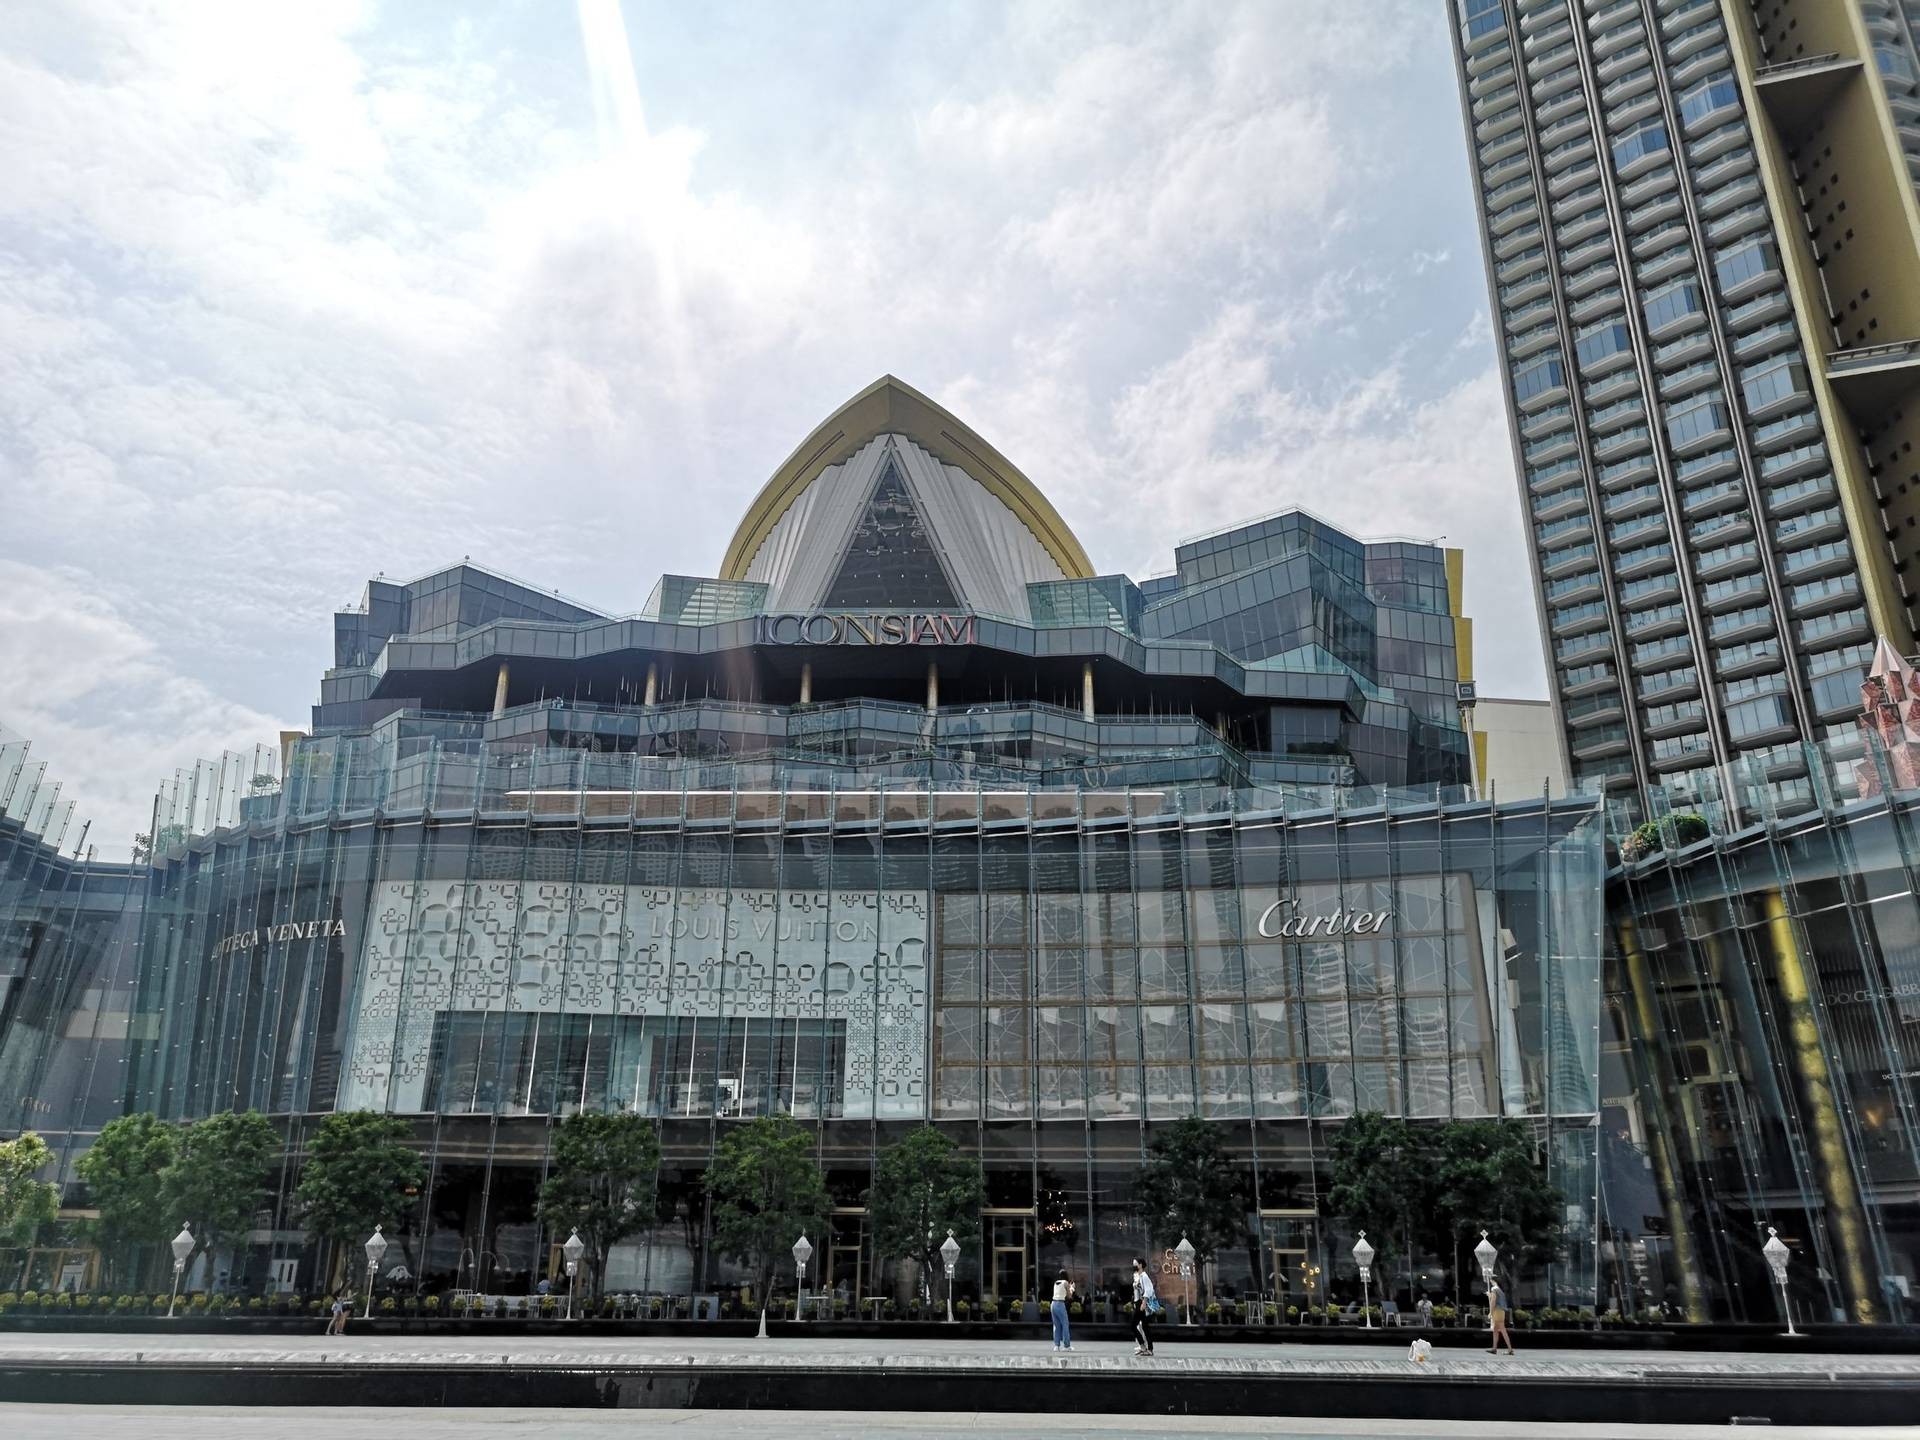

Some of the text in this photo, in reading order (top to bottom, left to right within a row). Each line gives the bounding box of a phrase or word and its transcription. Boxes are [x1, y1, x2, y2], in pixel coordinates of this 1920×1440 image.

[753, 613, 977, 646] ICONSIAM
[267, 919, 347, 943] VENETA
[651, 918, 740, 941] LOUIS
[1258, 898, 1391, 938] Cartier
